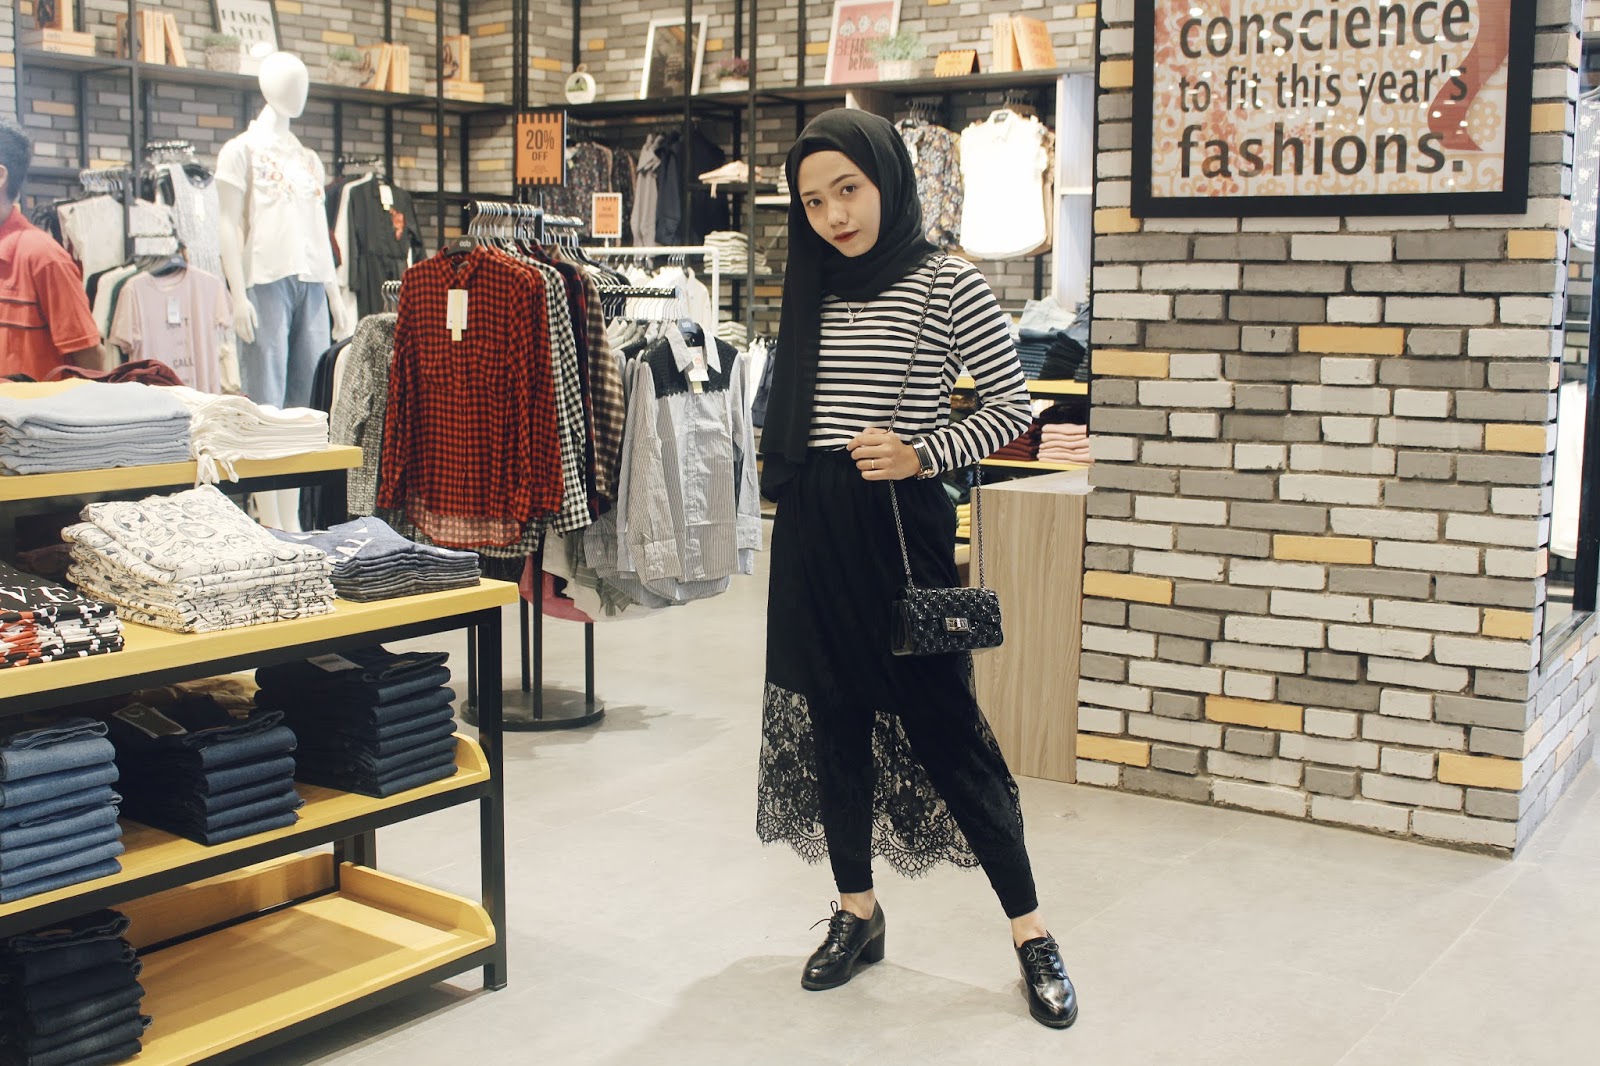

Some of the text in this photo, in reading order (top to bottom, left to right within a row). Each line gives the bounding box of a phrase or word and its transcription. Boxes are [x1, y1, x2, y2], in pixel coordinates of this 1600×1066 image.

[1179, 0, 1471, 58] conscience
[1178, 54, 1468, 115] to fit this year's
[526, 129, 555, 150] 20%
[531, 151, 549, 161] OFF
[1177, 121, 1464, 179] fashions.
